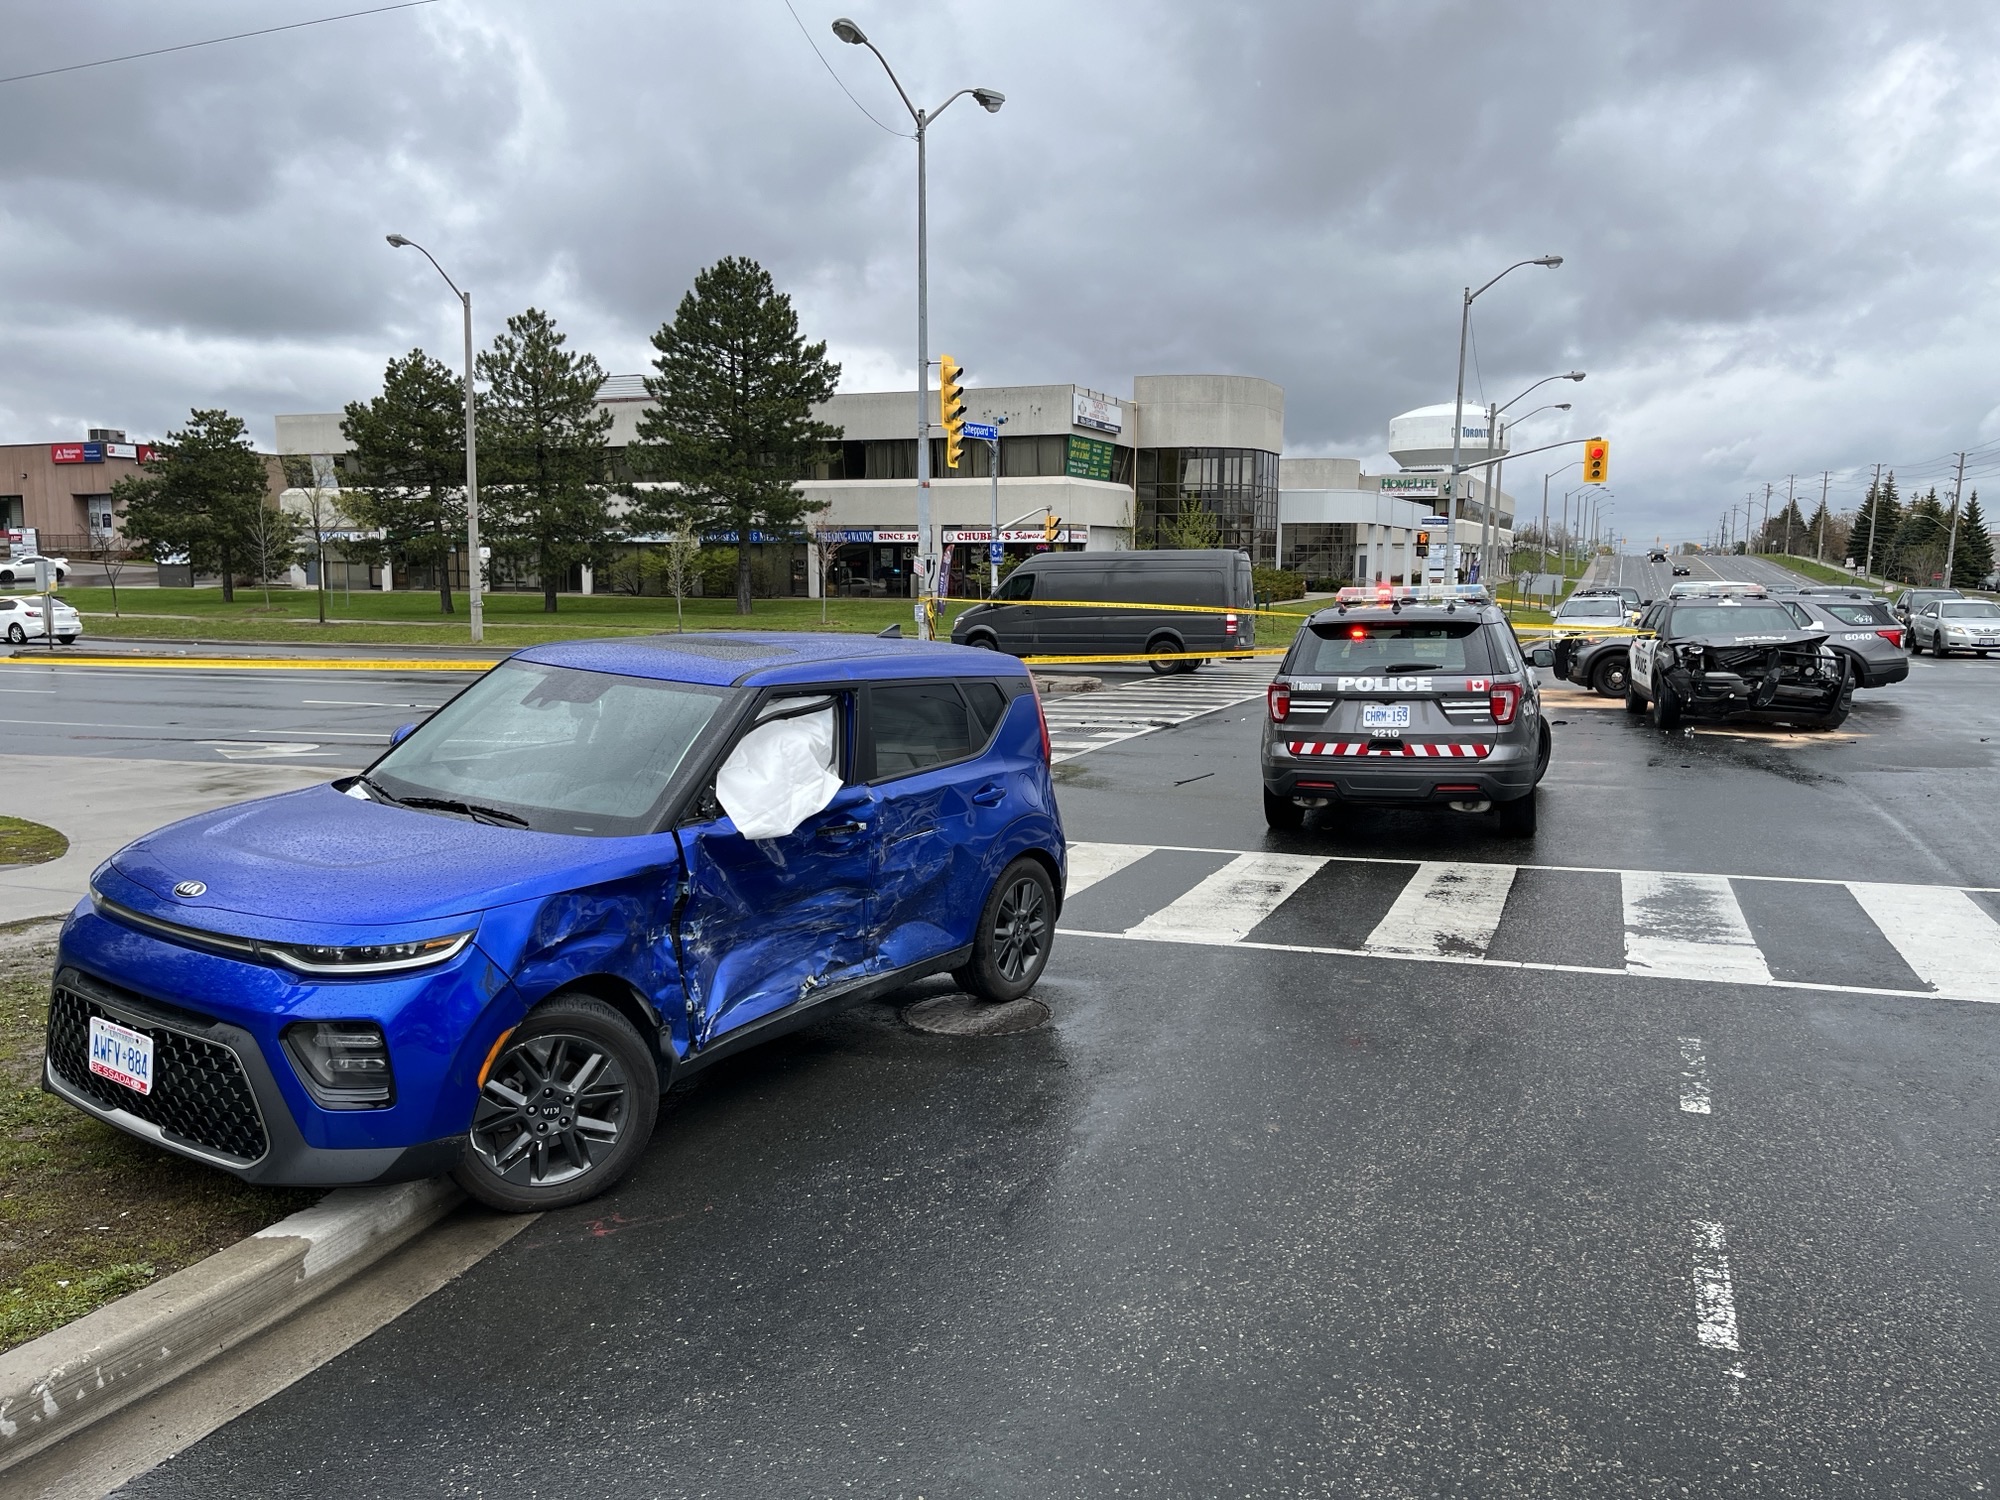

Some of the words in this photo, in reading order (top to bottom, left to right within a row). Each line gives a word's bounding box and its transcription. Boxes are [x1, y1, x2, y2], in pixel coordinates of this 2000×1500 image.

[964, 423, 988, 437] Sheppard
[993, 427, 997, 437] E
[851, 531, 873, 542] WAXING
[957, 532, 1011, 541] CHUBB'S
[1845, 633, 1872, 641] 6040
[1634, 654, 1647, 675] POLICE
[1337, 677, 1432, 691] POLICE
[1372, 729, 1400, 738] 4210
[91, 1062, 131, 1086] BESSADA
[543, 1107, 560, 1115] KIA
